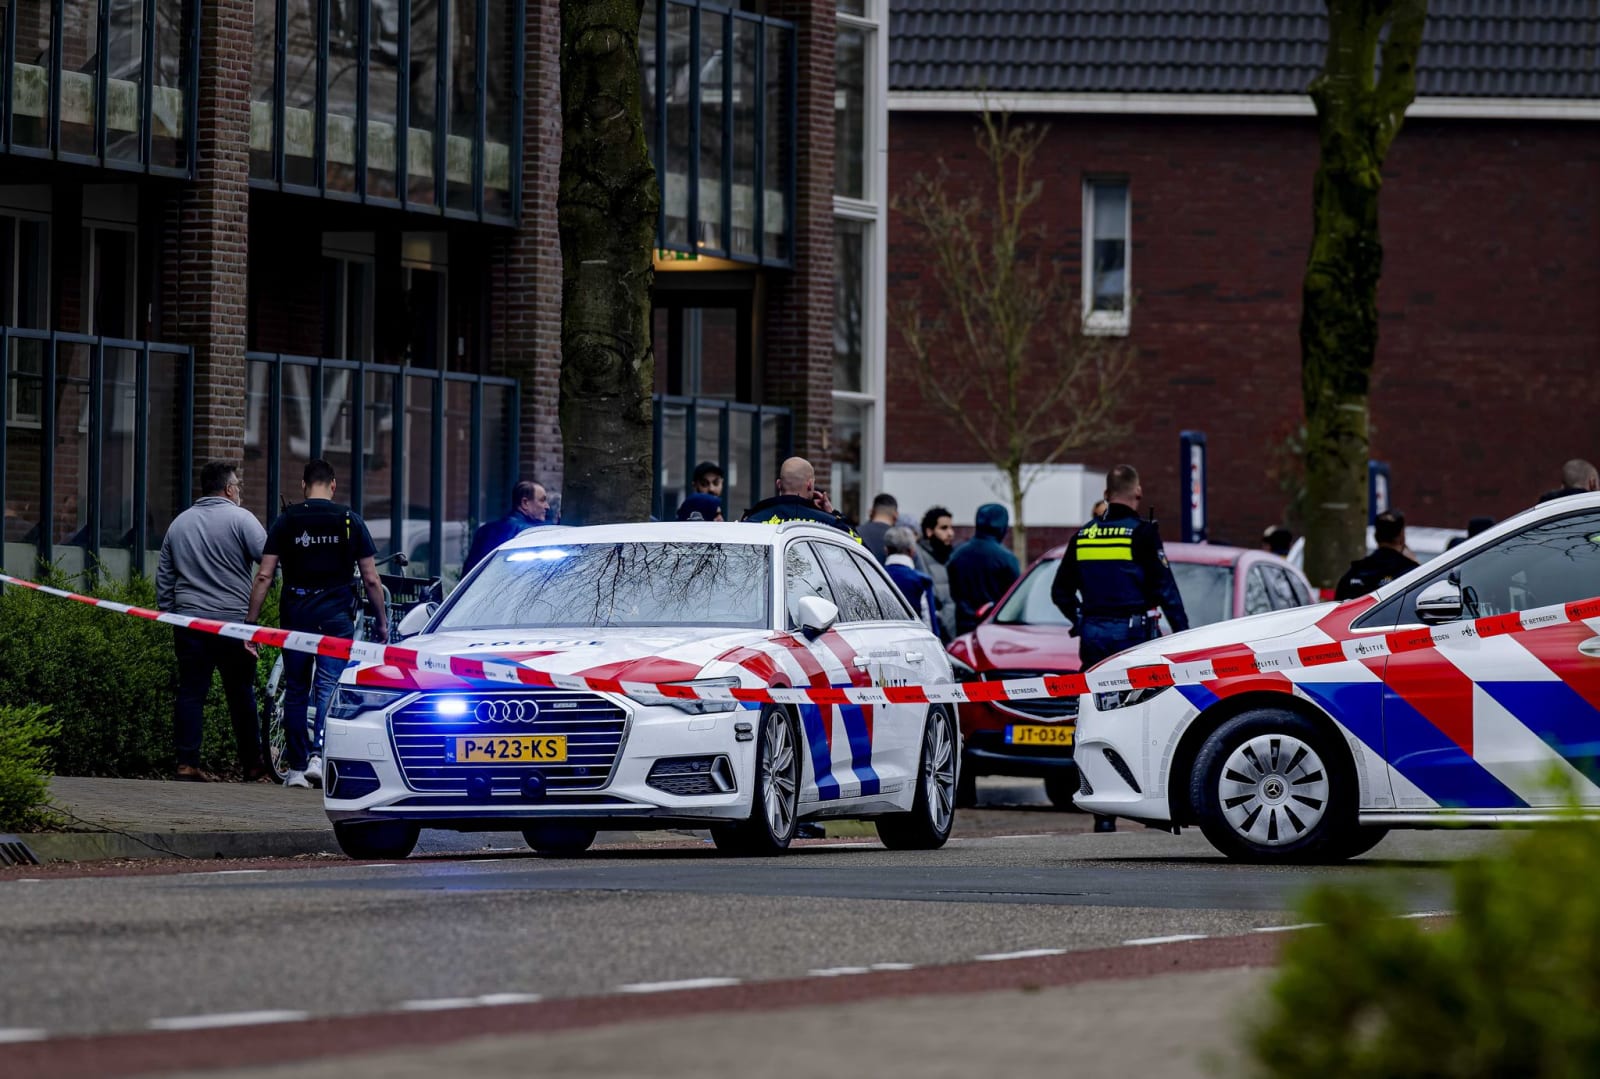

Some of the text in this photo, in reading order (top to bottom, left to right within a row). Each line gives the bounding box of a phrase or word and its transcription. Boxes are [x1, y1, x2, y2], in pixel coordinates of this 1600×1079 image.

[295, 530, 339, 547] POLITIE
[1082, 523, 1126, 539] POLITIE
[1011, 687, 1038, 695] BETREDEN
[1111, 678, 1136, 686] BETREDEN
[1148, 671, 1177, 683] POLITIE
[1250, 659, 1280, 671] POLITIE
[1355, 641, 1385, 655] POLITIE
[1461, 624, 1492, 637] POLITIE
[1528, 614, 1558, 625] BETREDEN
[464, 739, 557, 759] P-423-KS
